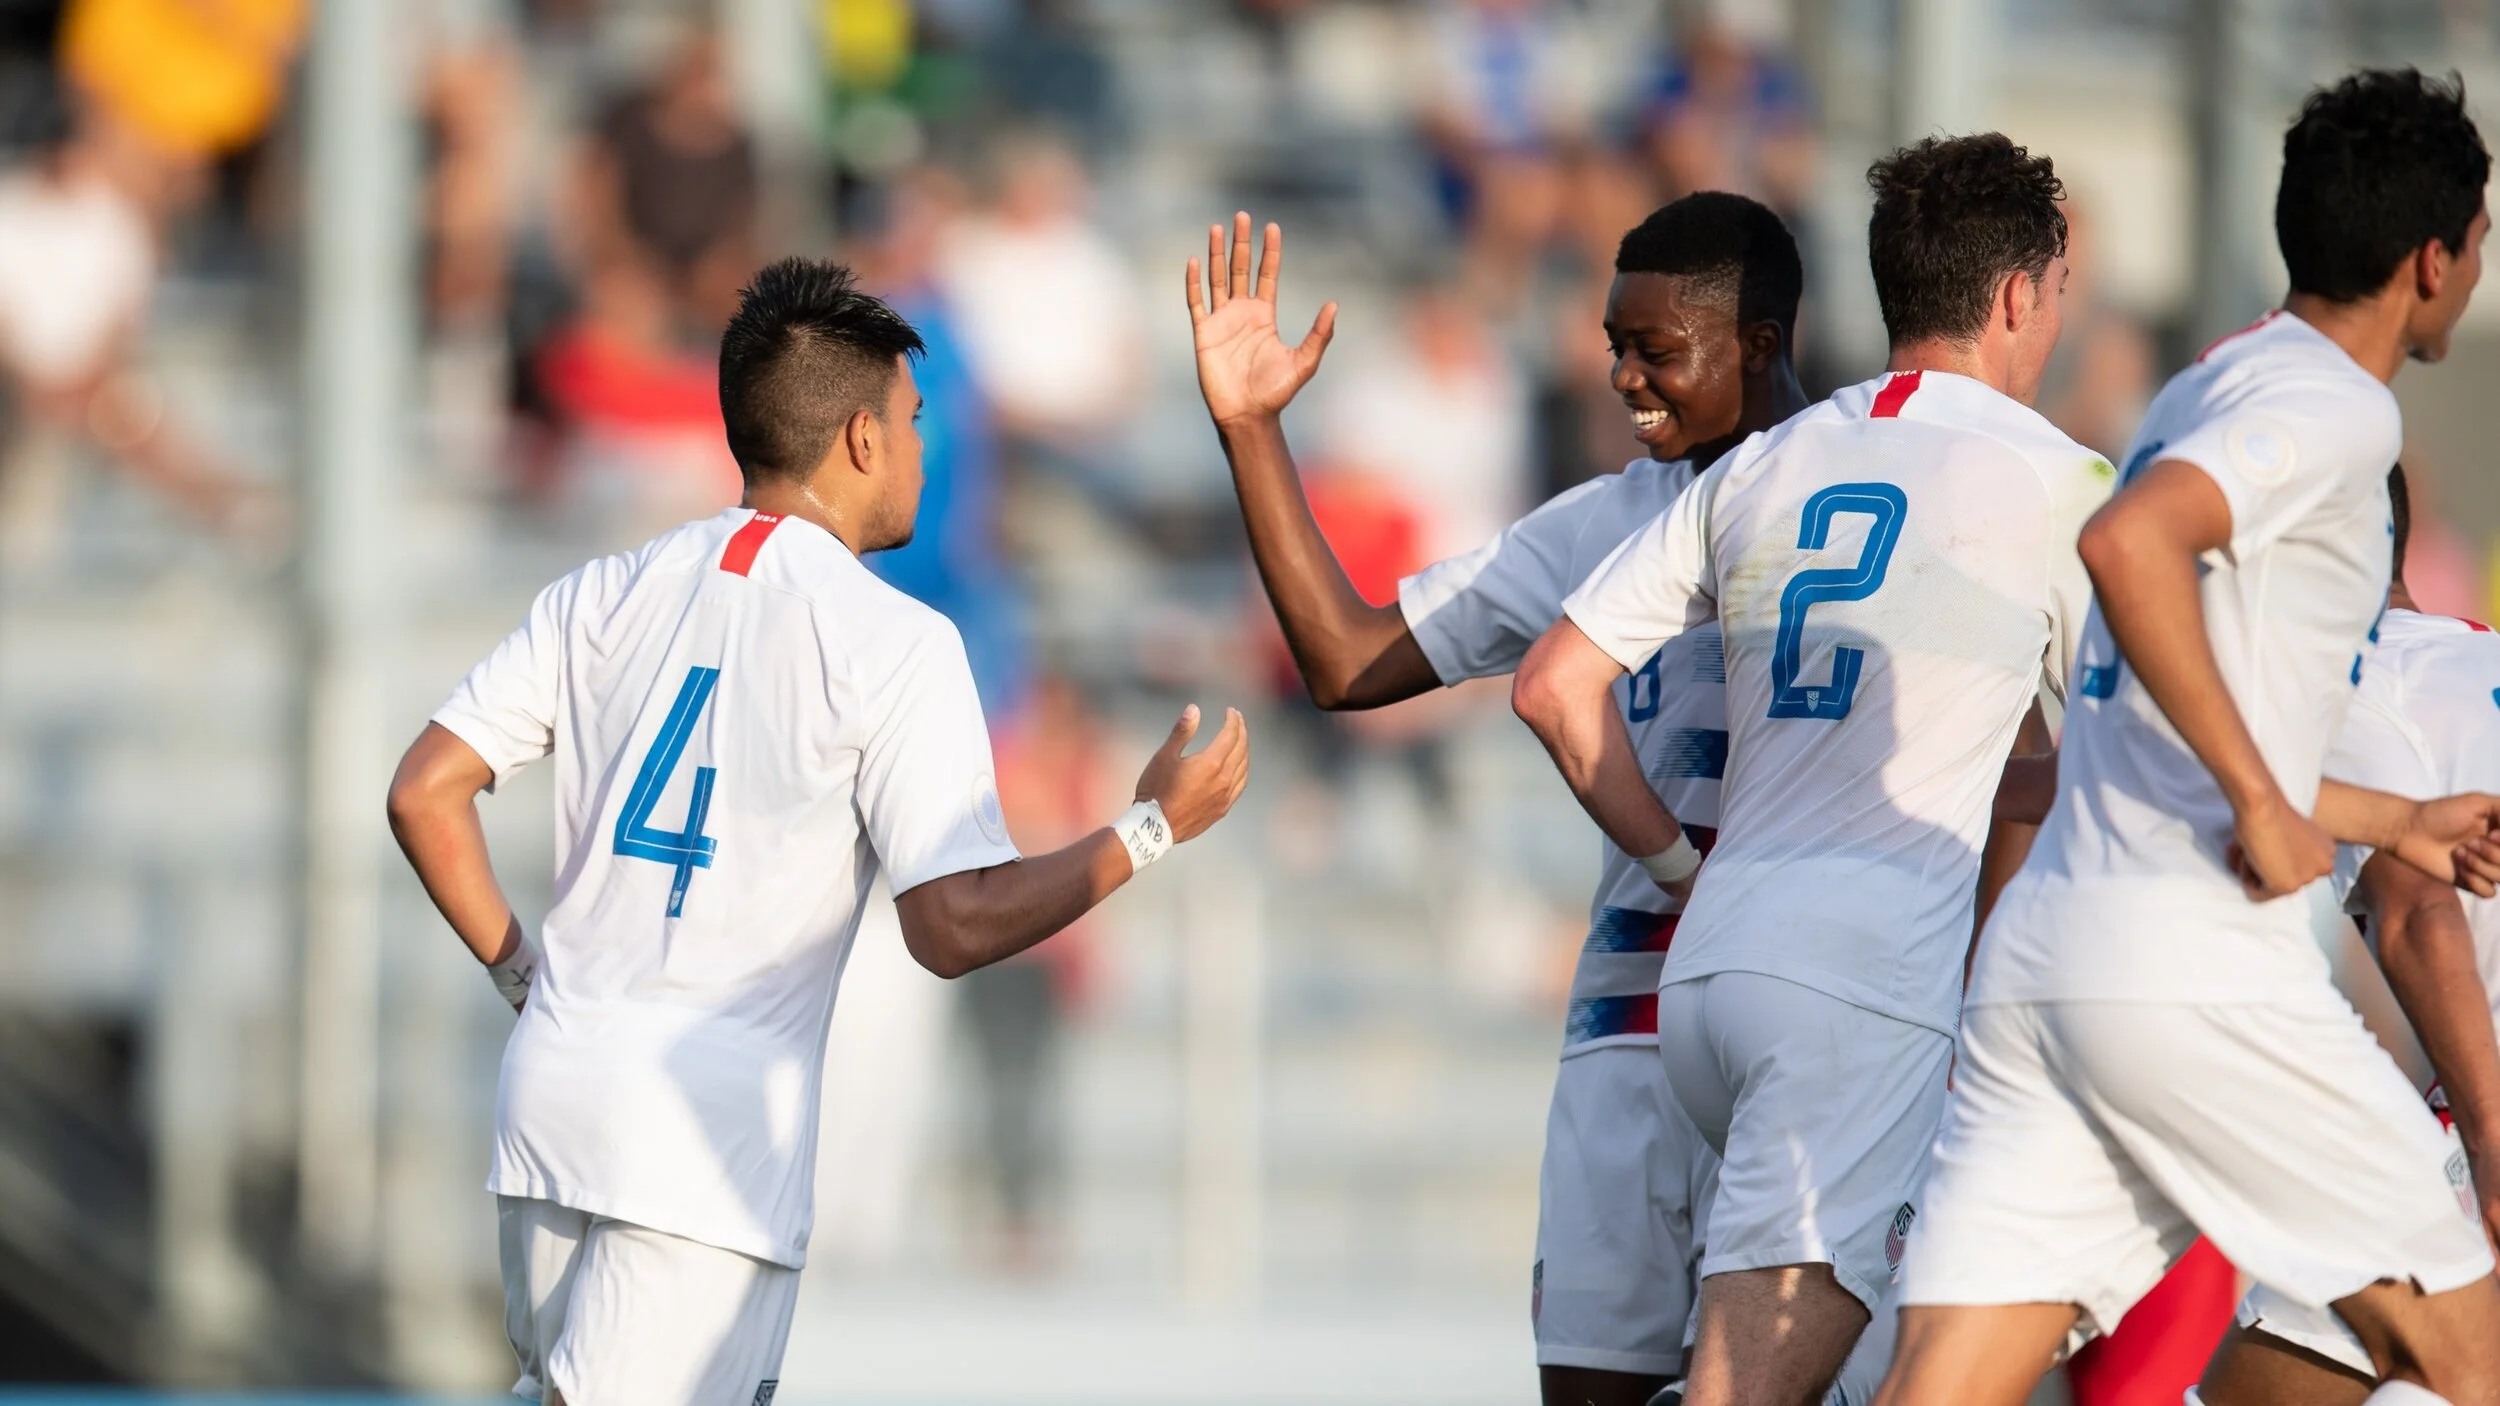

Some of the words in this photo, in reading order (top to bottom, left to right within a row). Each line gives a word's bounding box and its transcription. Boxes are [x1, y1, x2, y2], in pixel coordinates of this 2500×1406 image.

[754, 514, 778, 524] USA
[1767, 482, 1908, 721] 2
[612, 666, 720, 918] 4
[1141, 816, 1164, 843] MB
